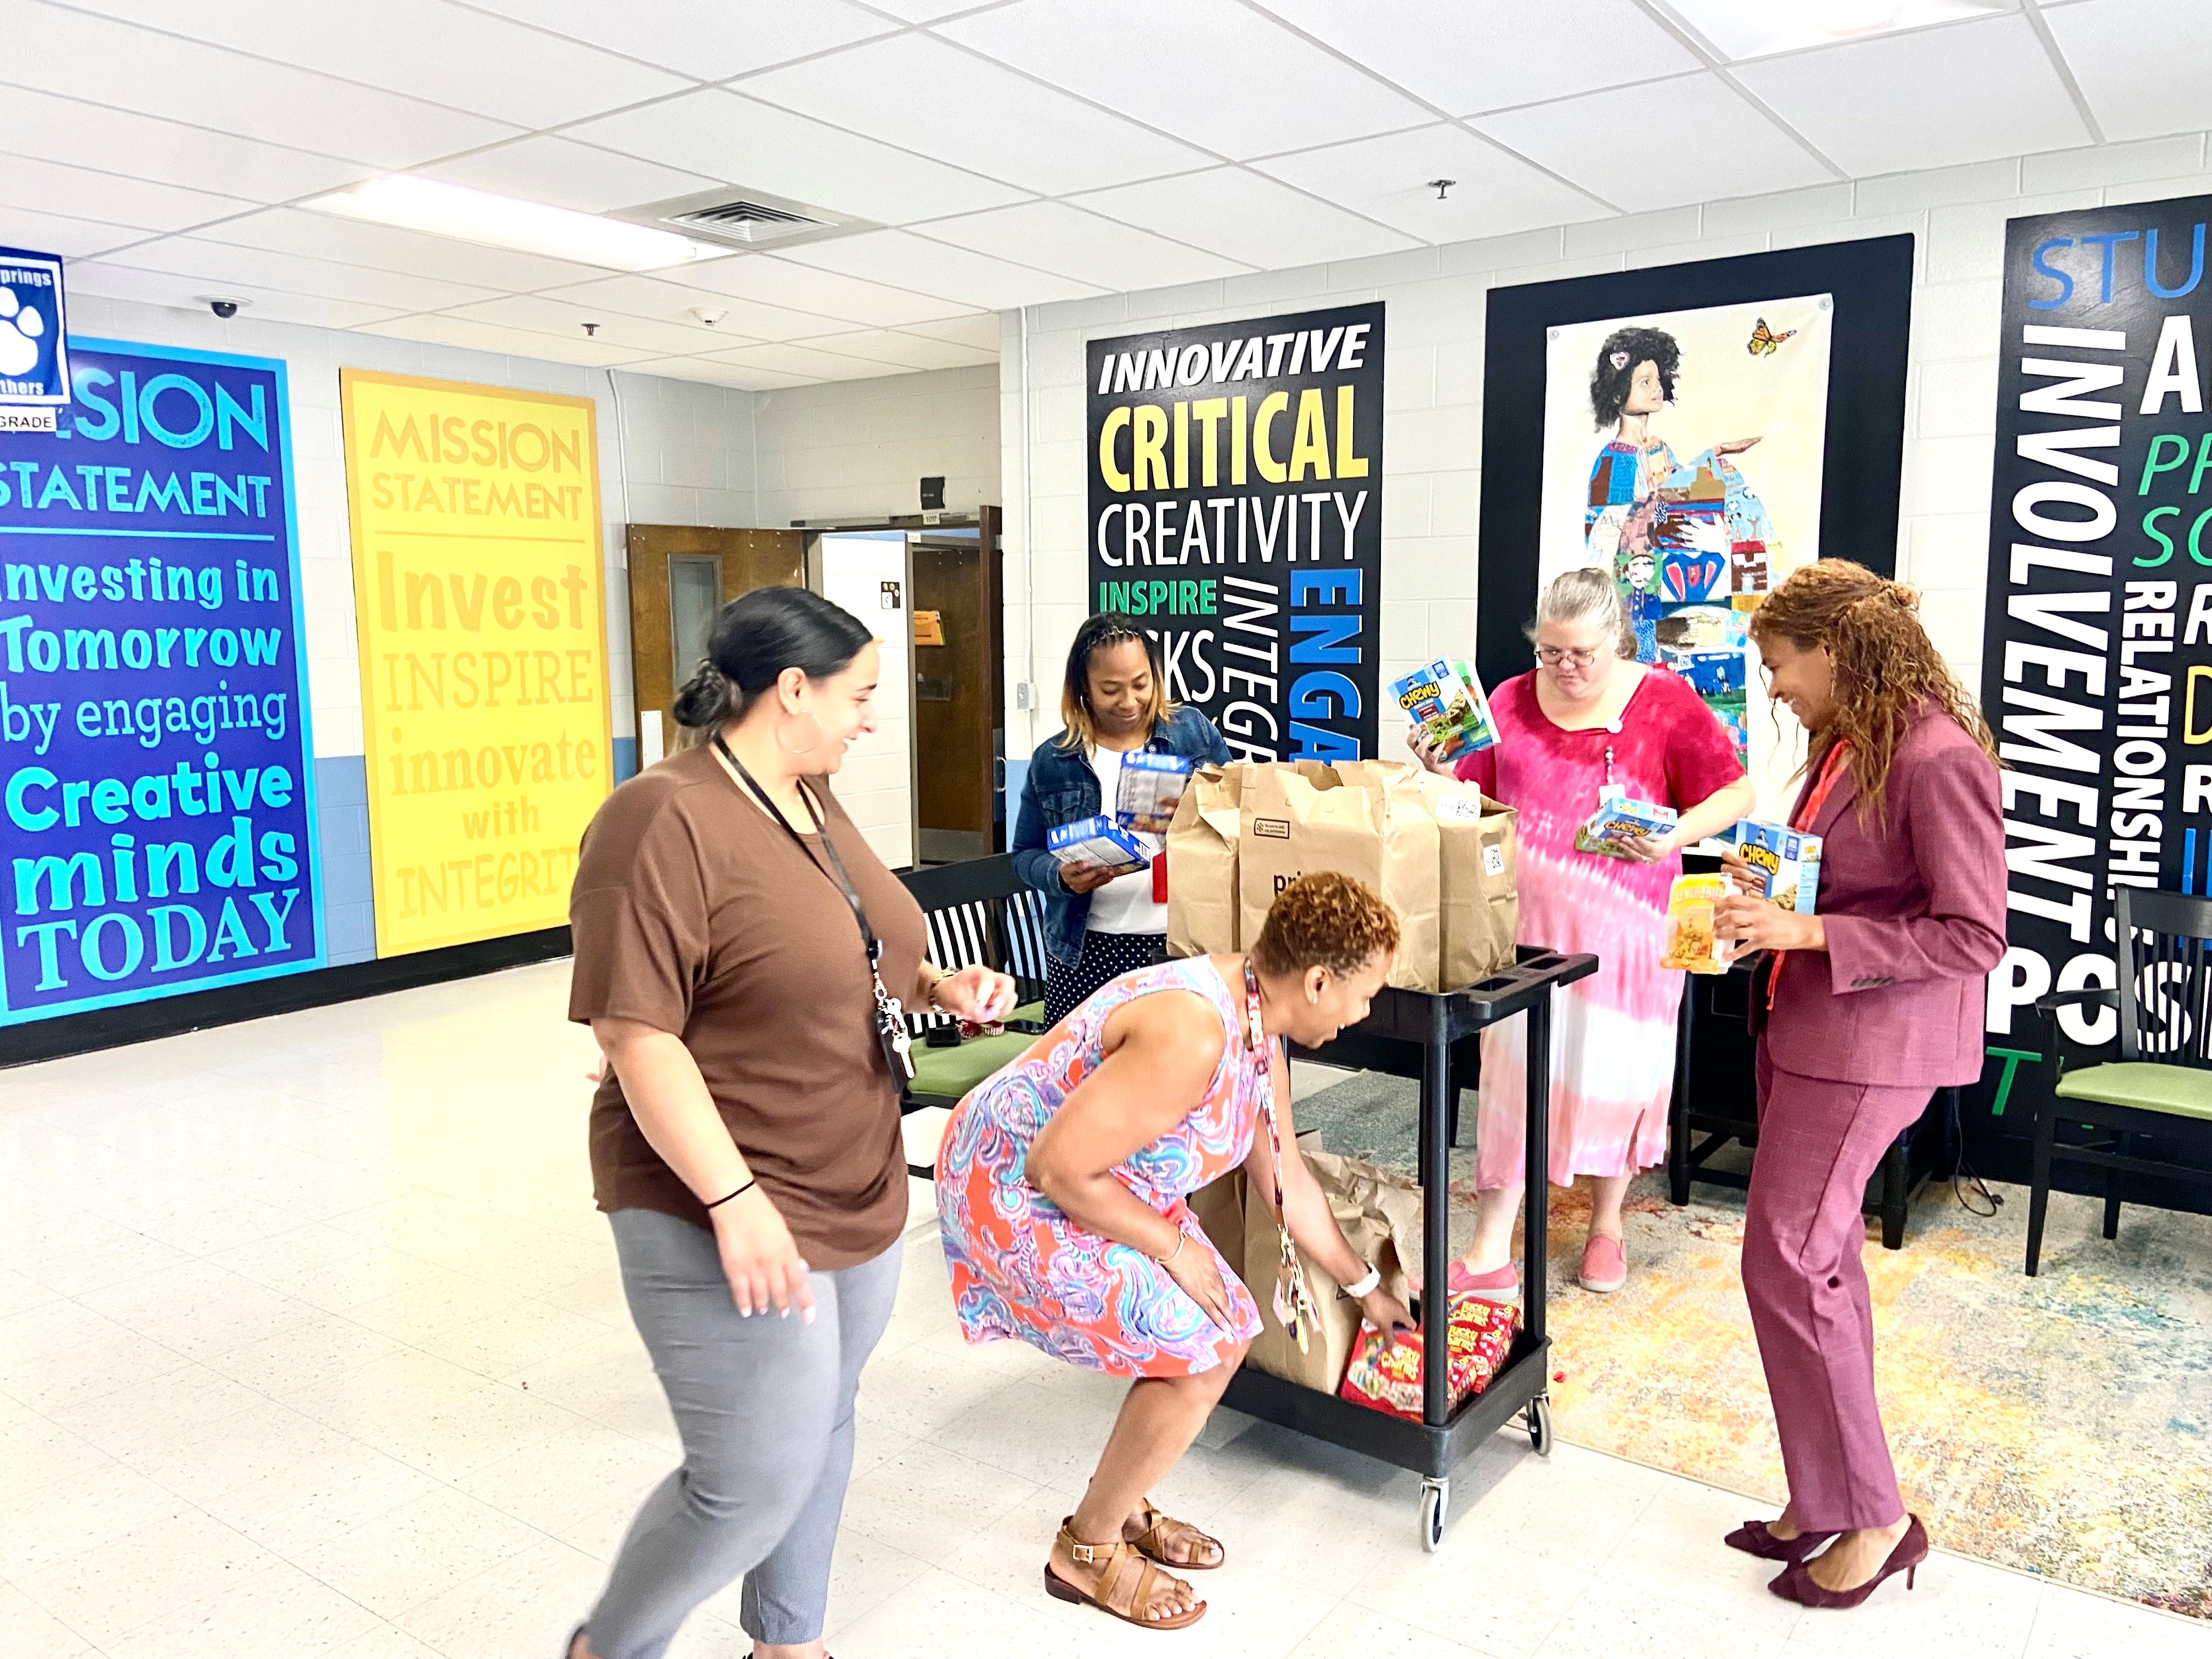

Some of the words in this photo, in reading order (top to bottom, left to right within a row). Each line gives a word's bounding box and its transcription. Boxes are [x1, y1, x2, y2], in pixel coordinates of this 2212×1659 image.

[1098, 324, 1370, 395] INNOVATIVE
[56, 367, 268, 452] SION
[369, 410, 581, 474] MISSION
[1099, 385, 1369, 493] CRITICAL
[372, 472, 582, 521] STATEMENT
[1098, 491, 1368, 567] CREATIVITY
[0, 557, 223, 610] nvesting
[236, 558, 279, 602] in
[376, 550, 587, 632] Invest
[1100, 580, 1217, 615] INSPIRE
[0, 615, 281, 672] Tomorrow
[1146, 630, 1216, 702] KS
[1223, 575, 1279, 763] INTEGR
[1289, 568, 1363, 766] ENGA
[1999, 325, 2126, 944] INVOLVEMENT
[0, 681, 60, 755] by
[77, 680, 286, 747] engaging
[382, 650, 593, 712] INSPIRE
[5, 751, 292, 832] Creative
[390, 726, 596, 796] innovate
[2104, 581, 2177, 945] RELATIONSHI
[462, 795, 540, 839] with
[12, 816, 298, 915] minds
[396, 845, 579, 919] INTEGRIT
[16, 888, 300, 991] TODAY
